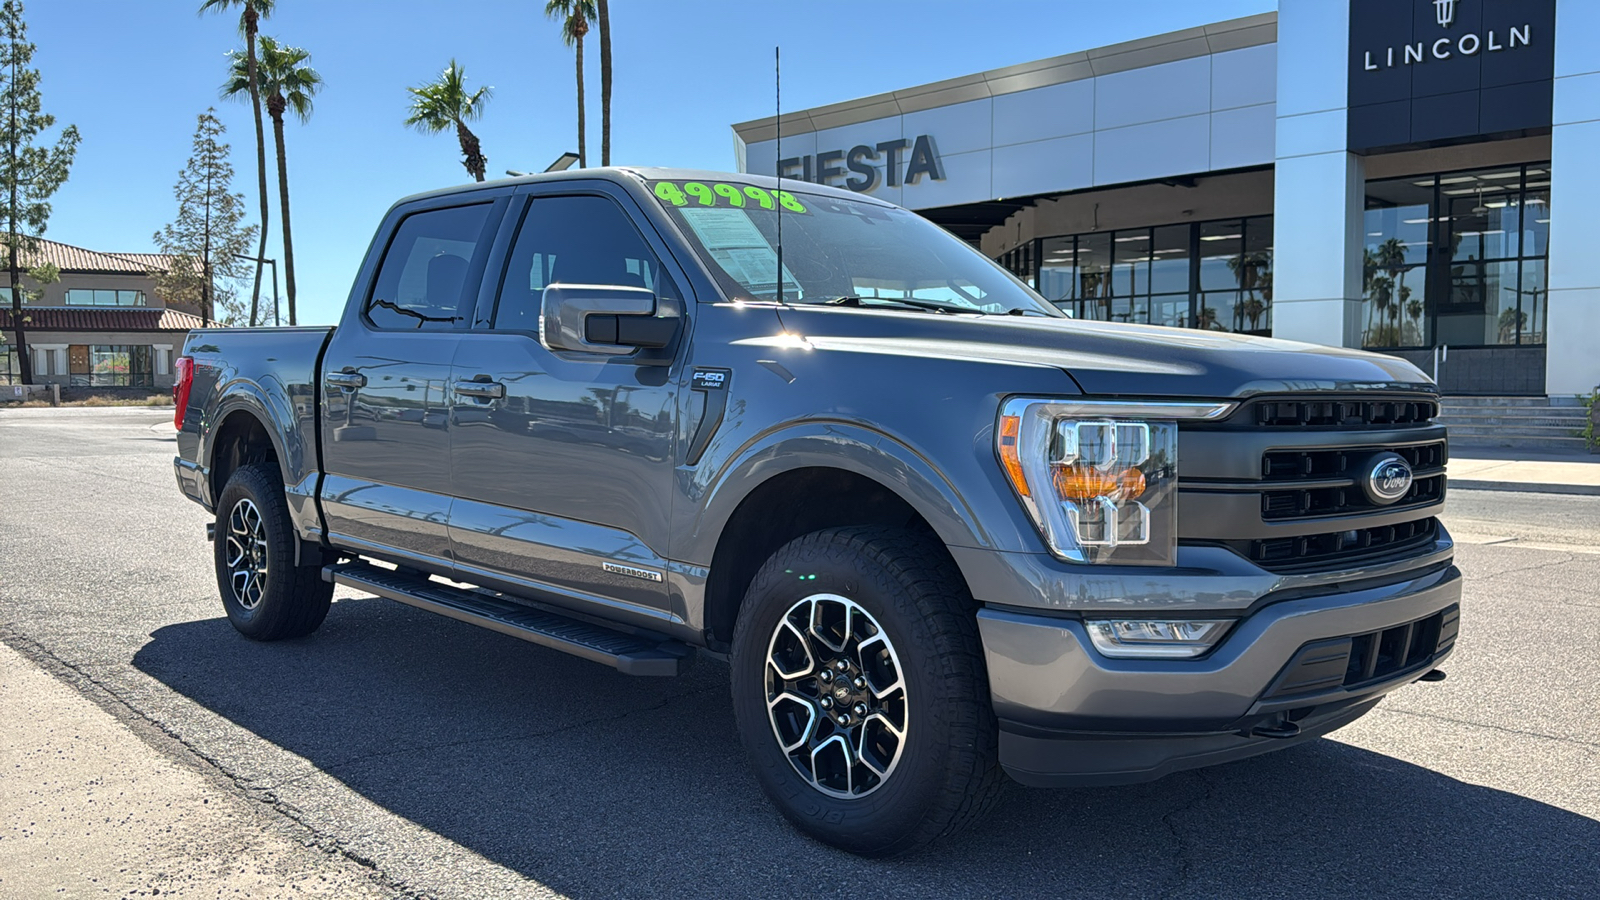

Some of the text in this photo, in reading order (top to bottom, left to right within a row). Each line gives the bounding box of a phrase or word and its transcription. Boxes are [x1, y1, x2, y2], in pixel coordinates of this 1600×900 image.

[1364, 24, 1531, 71] LINCOLN
[654, 181, 807, 214] 49998
[1383, 467, 1407, 489] Ford
[604, 564, 658, 580] POWERBOOST
